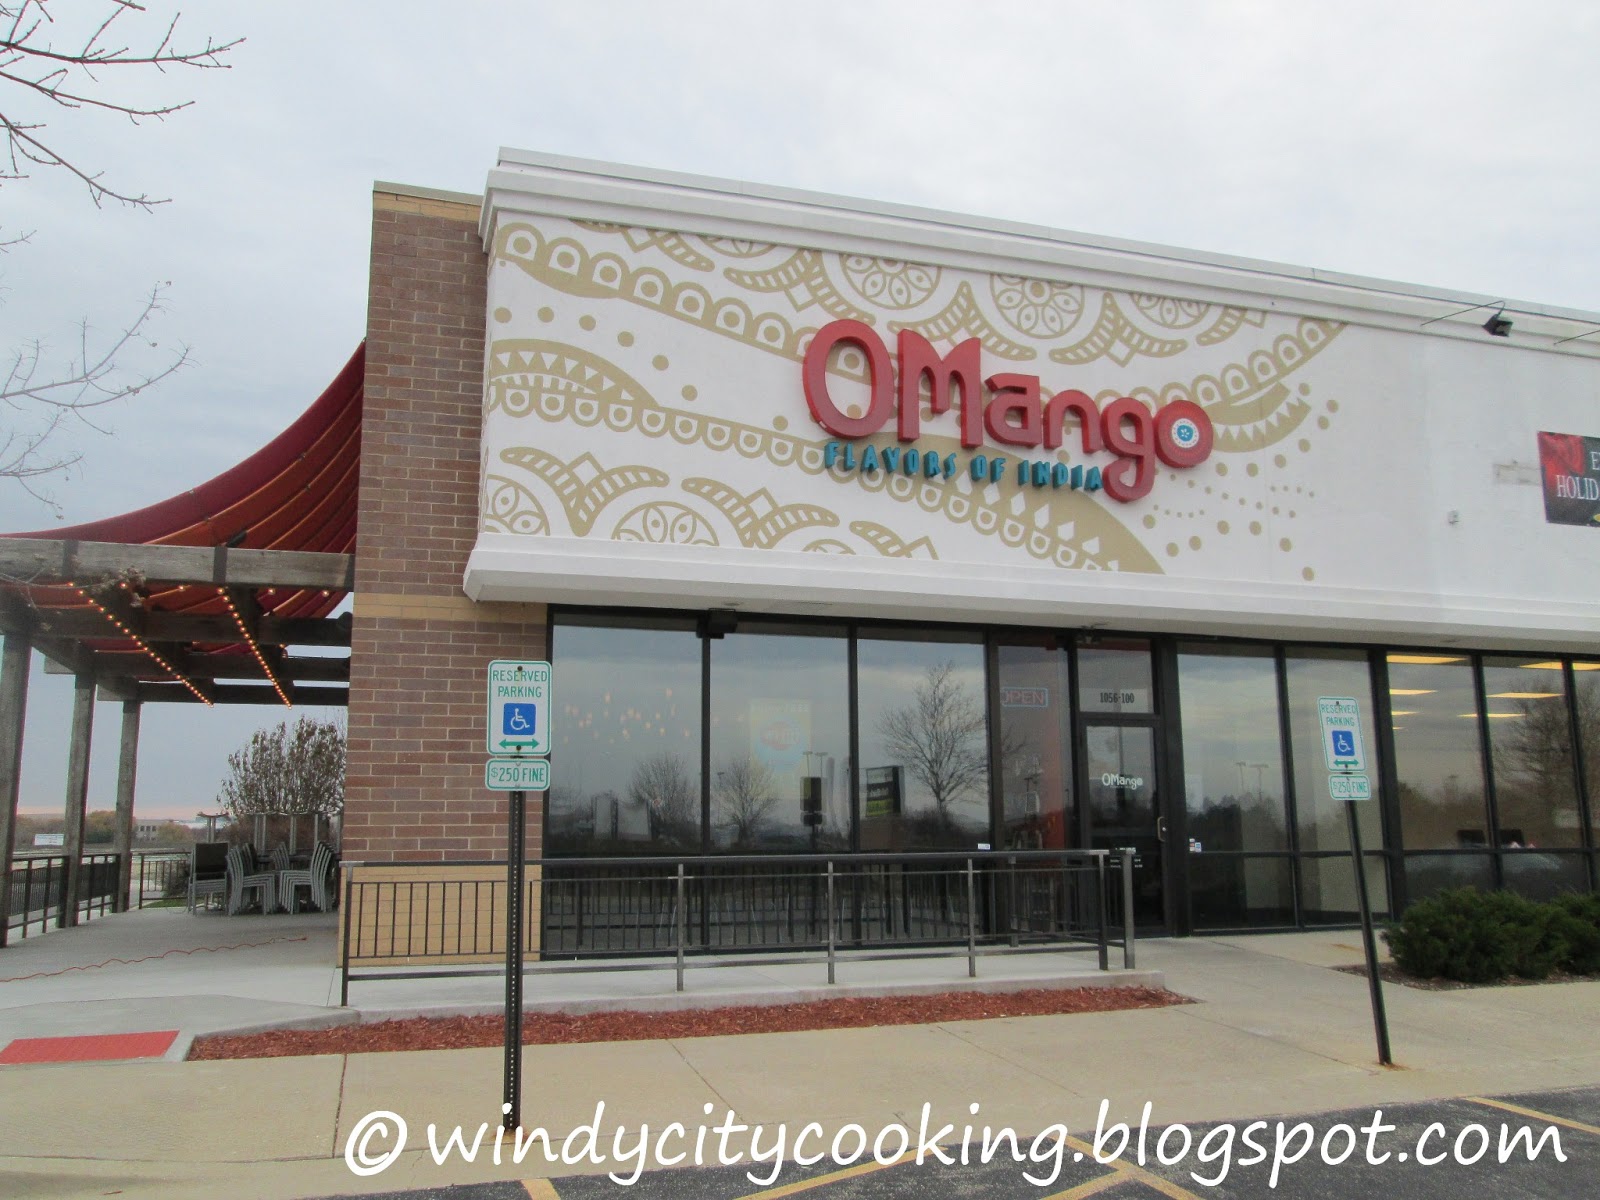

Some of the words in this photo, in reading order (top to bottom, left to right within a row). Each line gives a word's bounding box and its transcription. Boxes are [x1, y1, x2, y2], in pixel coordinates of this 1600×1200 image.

[802, 318, 1214, 503] OMango
[824, 441, 957, 481] FLAVORS
[970, 454, 1006, 484] OF
[1017, 459, 1104, 492] INDIA
[492, 669, 548, 682] RESERVED
[497, 685, 542, 698] PARKING
[1100, 692, 1135, 704] 1056-100
[1321, 703, 1357, 715] RESERVED
[1326, 716, 1355, 727] PARKING
[490, 767, 520, 783] $250
[521, 767, 546, 783] FINE
[1102, 773, 1144, 790] OMango
[1352, 781, 1368, 794] FINE
